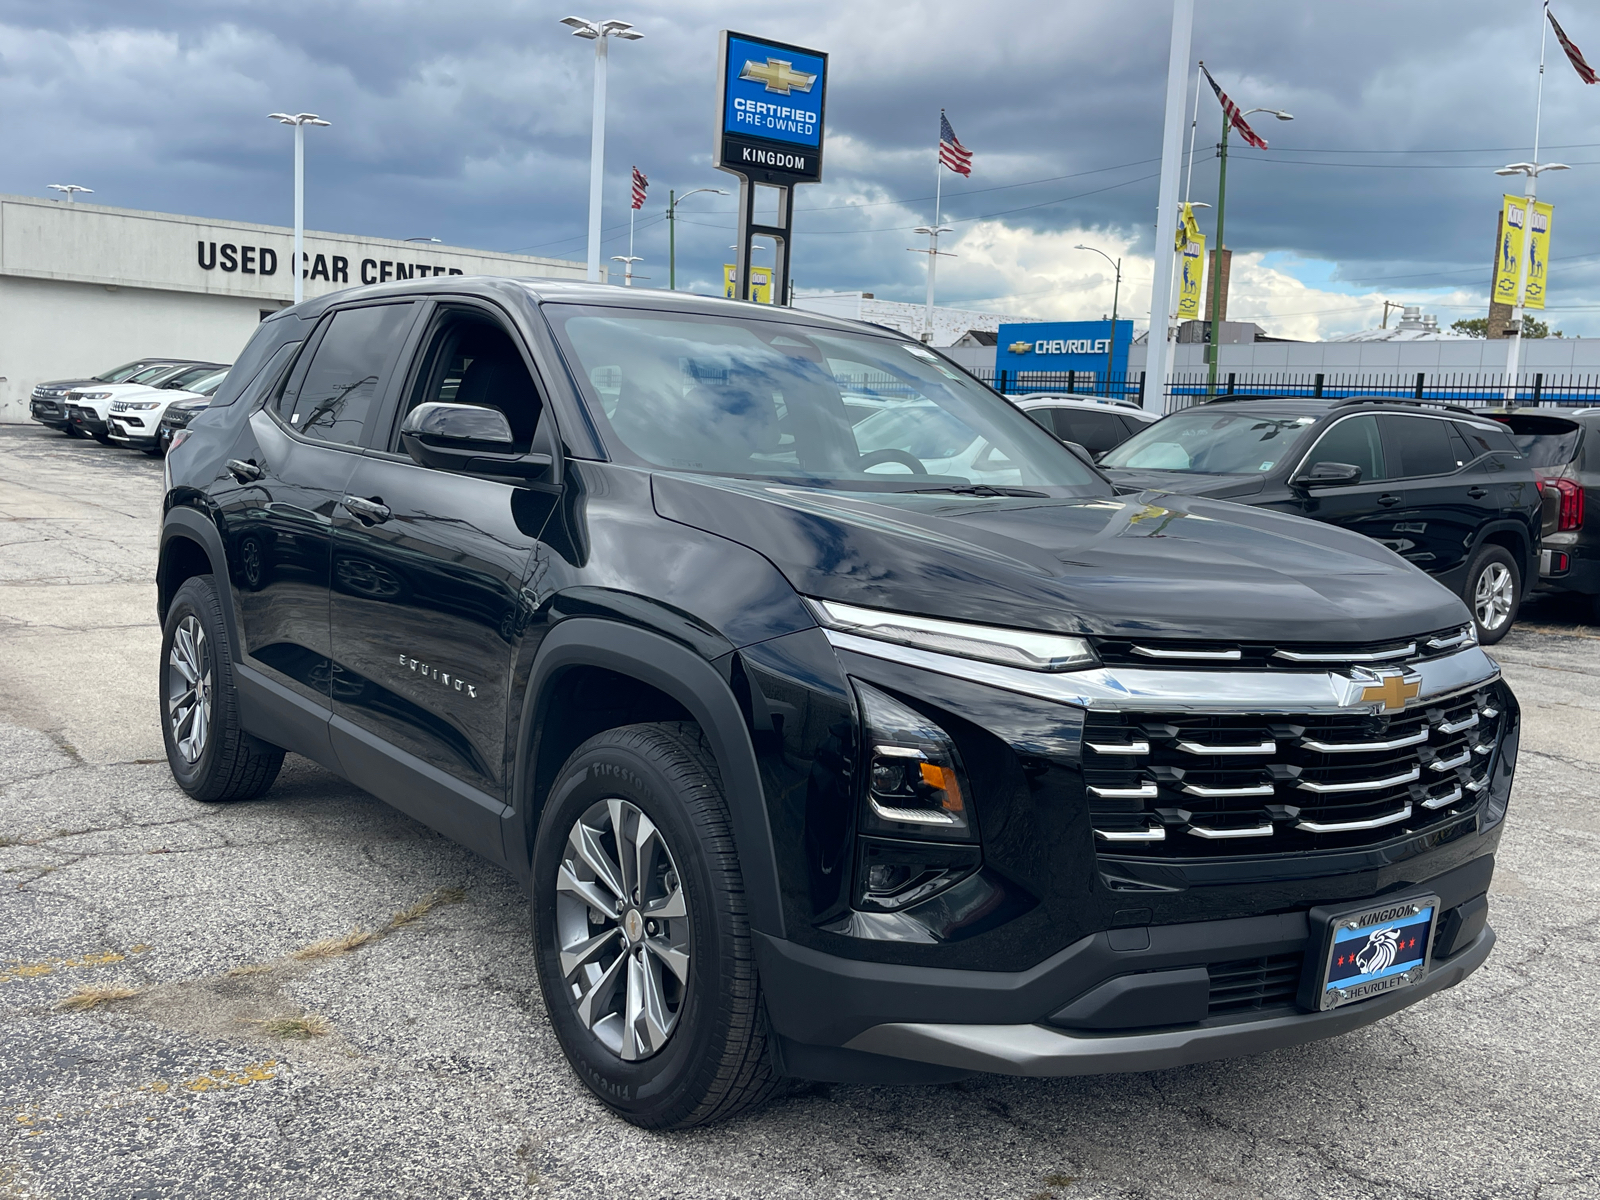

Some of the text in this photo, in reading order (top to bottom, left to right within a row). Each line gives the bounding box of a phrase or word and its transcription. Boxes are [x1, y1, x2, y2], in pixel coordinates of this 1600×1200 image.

[734, 98, 816, 124] CERTIFIED
[737, 112, 813, 135] PRE-OWNED
[742, 147, 805, 170] KINGDOM
[197, 241, 278, 276] USED
[292, 251, 349, 284] CAR
[1035, 339, 1111, 354] CHEVROLET
[399, 654, 478, 698] EQUINOX
[592, 761, 661, 805] Fireston
[1359, 903, 1416, 927] KINGDOM
[1345, 976, 1402, 1000] CHEVROLET
